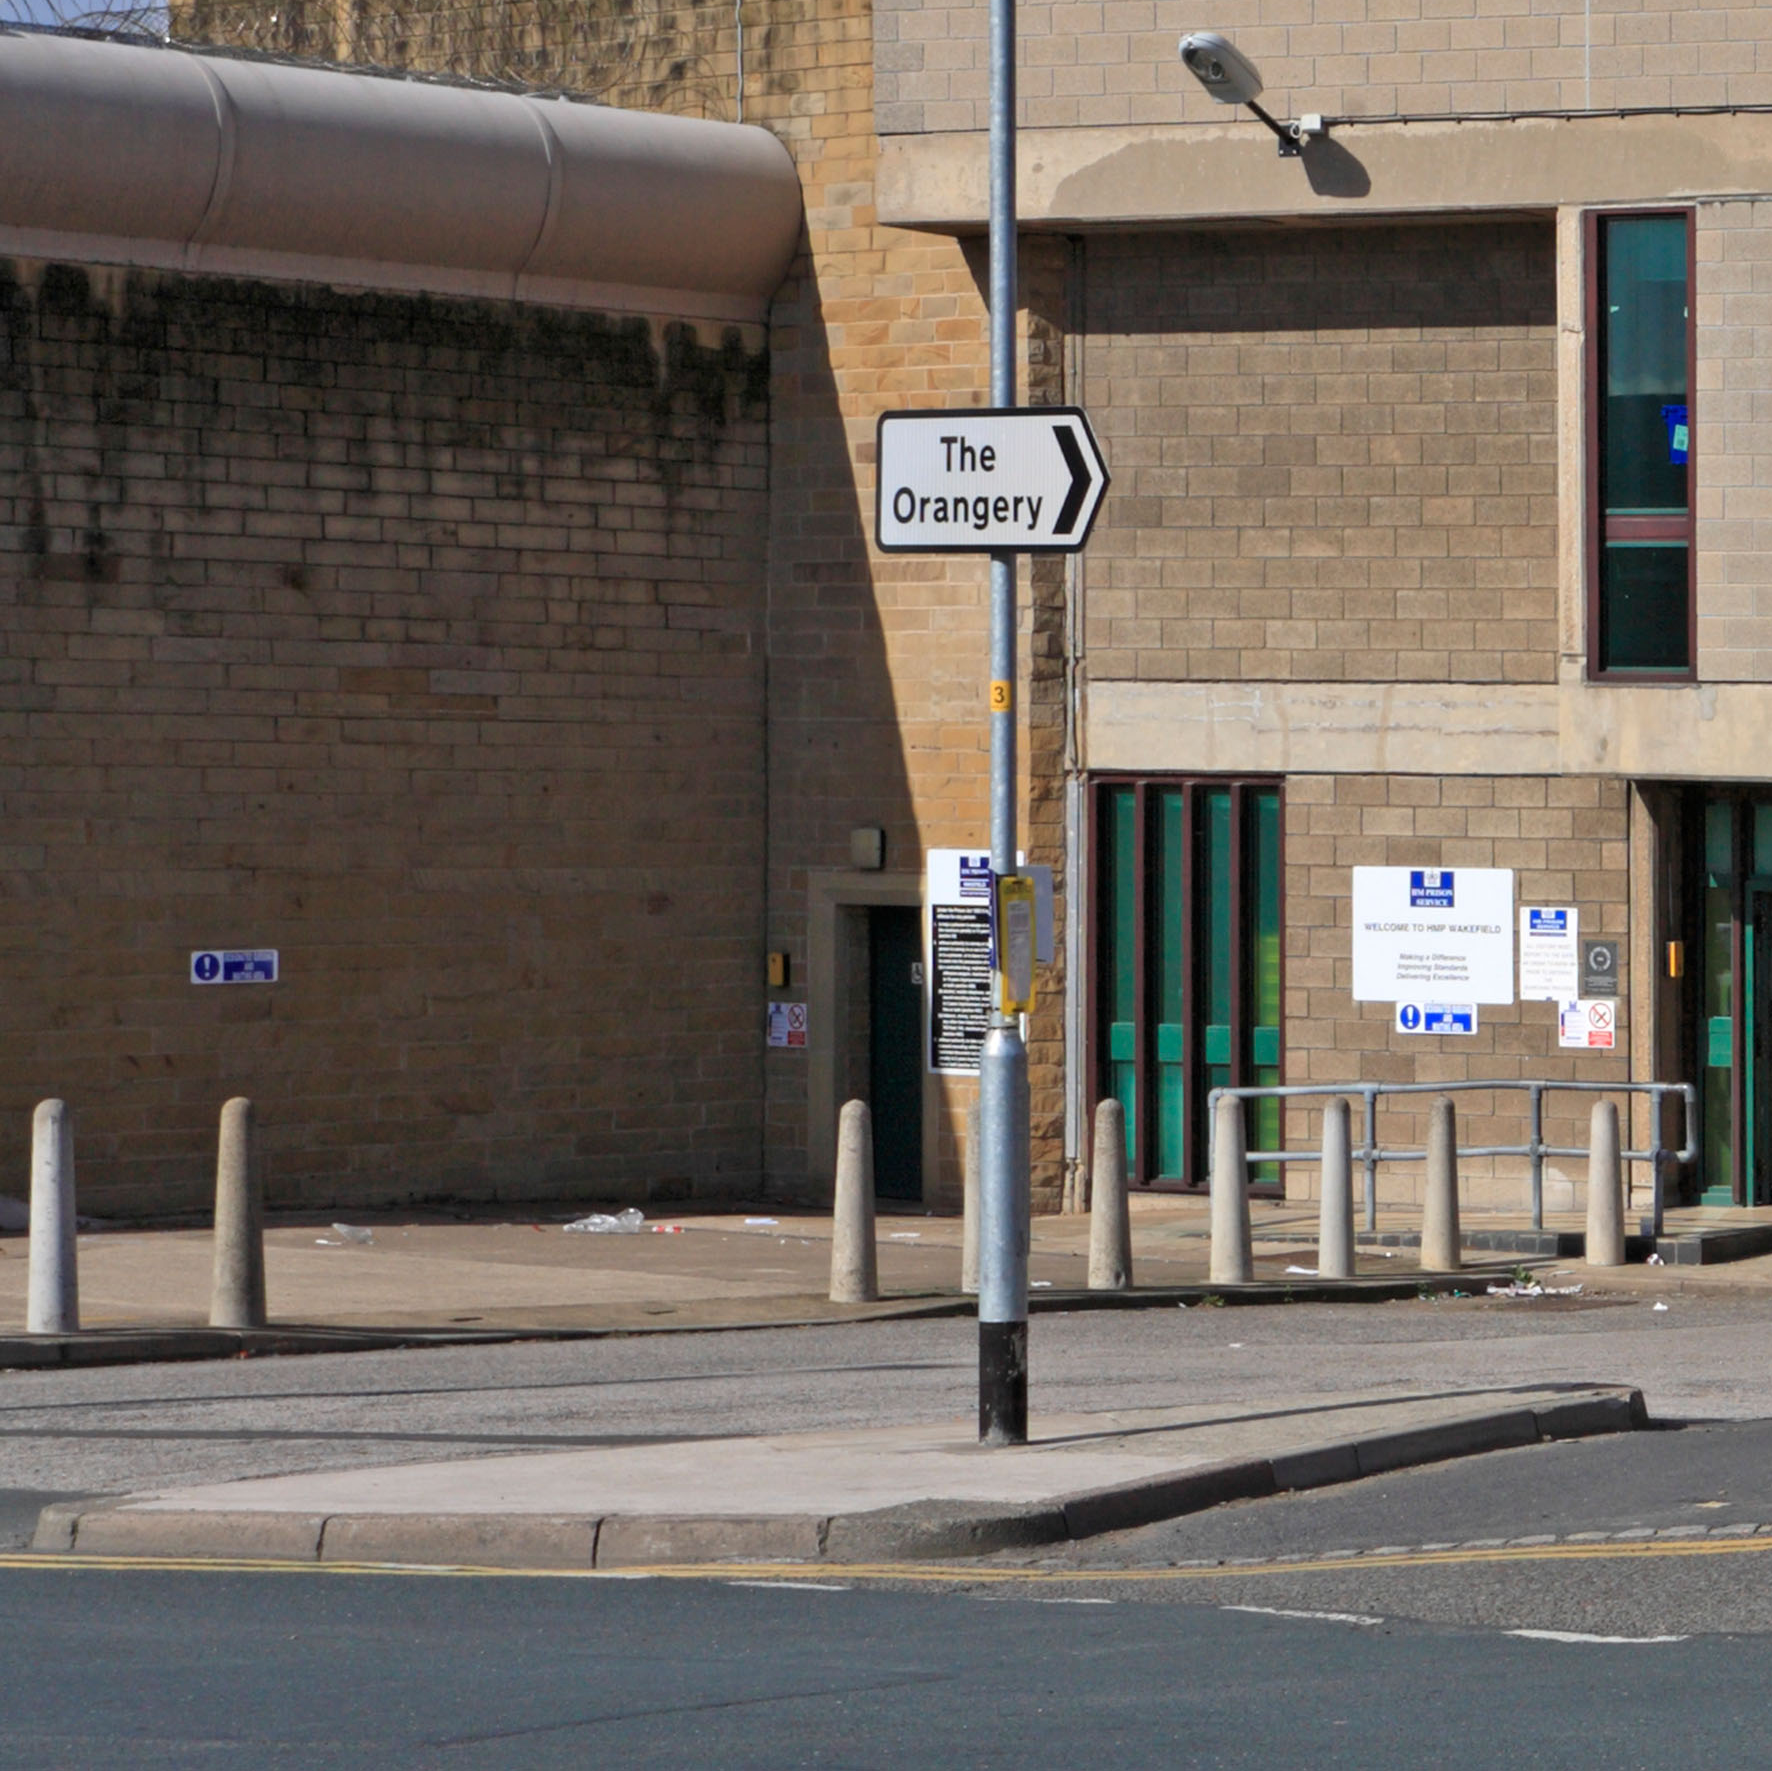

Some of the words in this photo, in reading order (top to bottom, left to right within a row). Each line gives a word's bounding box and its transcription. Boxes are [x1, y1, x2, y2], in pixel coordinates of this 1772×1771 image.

[940, 436, 996, 472] The
[893, 486, 1043, 531] Orangery
[994, 686, 1005, 703] 3
[1364, 923, 1409, 932] WELCOME
[1413, 923, 1424, 932] TO
[1426, 924, 1446, 932] HMP
[1449, 924, 1501, 934] WAKEFIELD
[1399, 953, 1424, 962] Making
[1432, 954, 1467, 962] Difference
[1434, 963, 1468, 971] Standards
[1396, 973, 1431, 982] Delivering
[1433, 974, 1470, 982] Excellence
